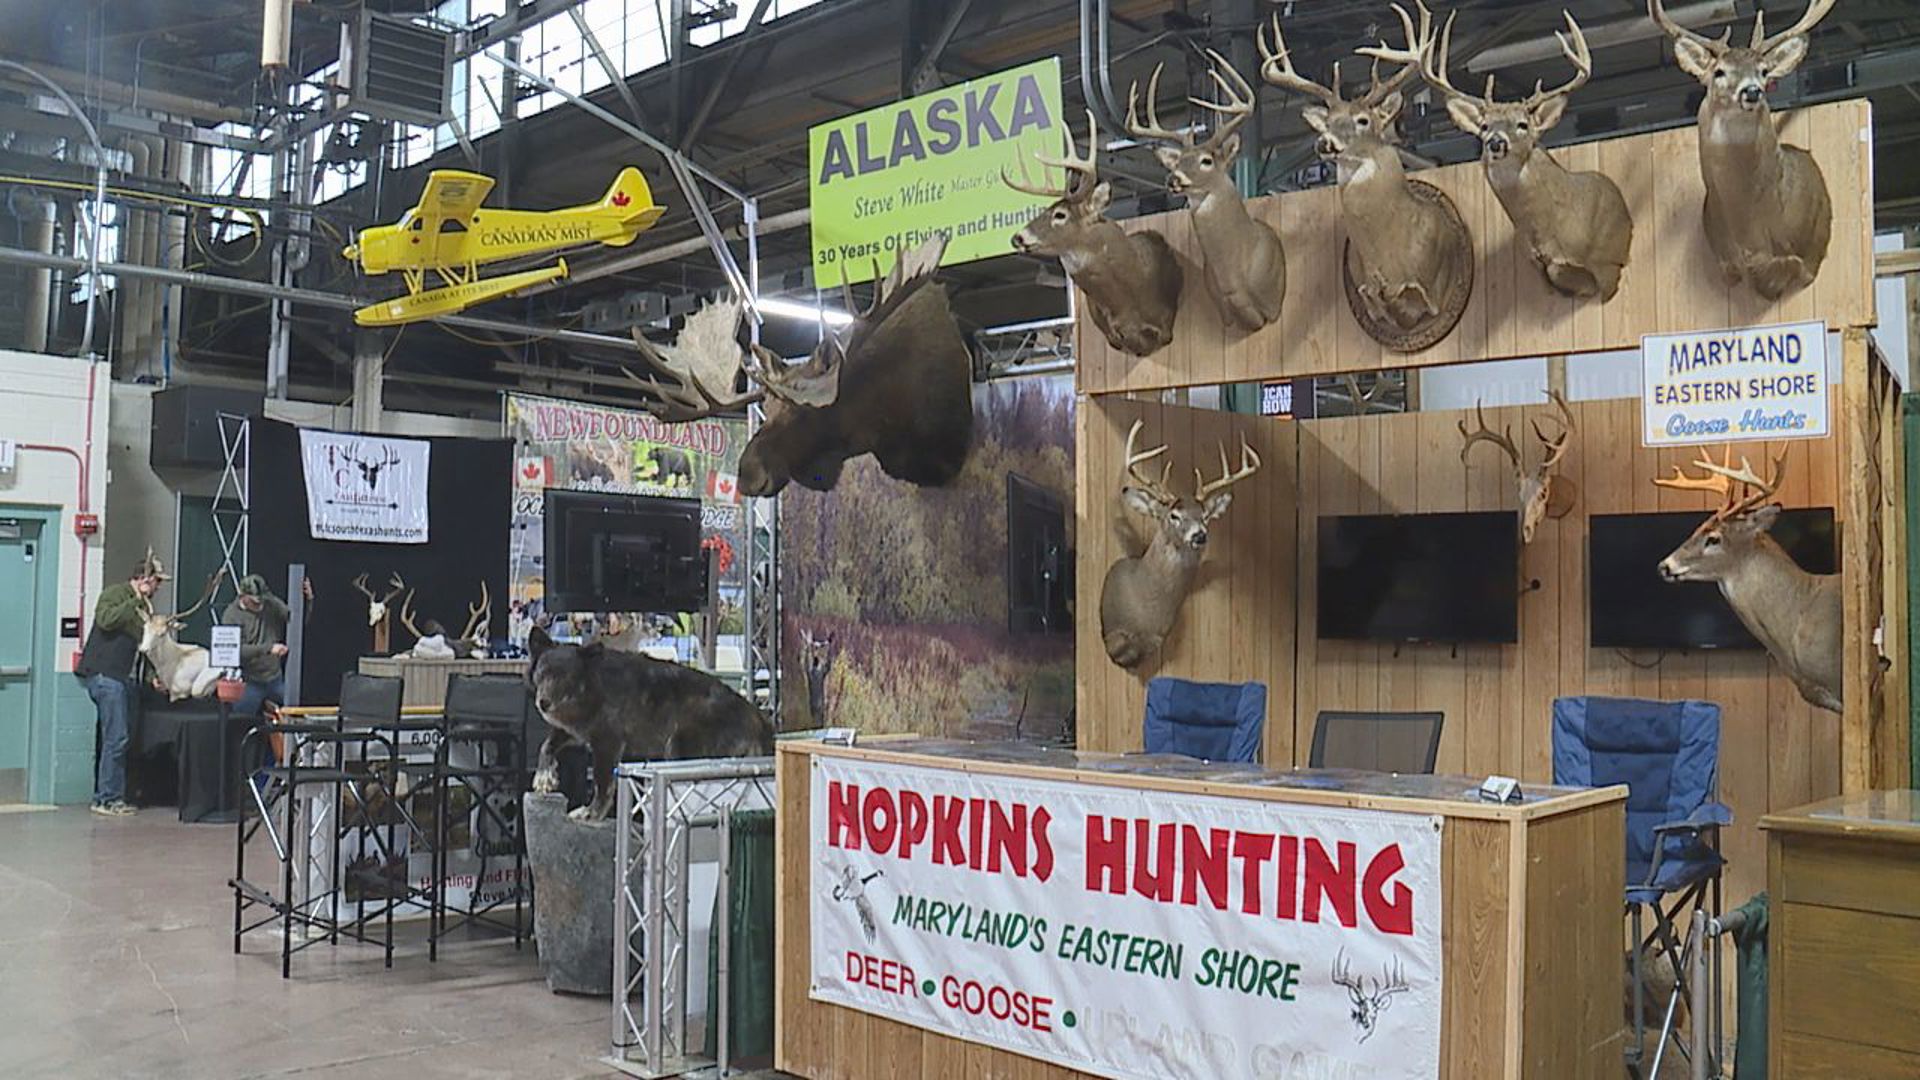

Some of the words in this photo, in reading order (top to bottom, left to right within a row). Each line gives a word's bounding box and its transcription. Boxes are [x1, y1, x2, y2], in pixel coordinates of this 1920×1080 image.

[819, 74, 1052, 185] ALASKA
[854, 196, 894, 219] Steve
[900, 178, 945, 208] White
[951, 175, 983, 192] Master
[481, 227, 557, 246] CANADIAN
[561, 226, 592, 241] MIST
[819, 248, 836, 265] 30
[839, 242, 880, 260] Years
[957, 214, 987, 236] and
[1669, 333, 1801, 376] MARYLAND
[1655, 380, 1741, 404] EASTERN
[1749, 374, 1816, 398] SHORE
[533, 405, 727, 457] NEWFOUNDLAND
[1666, 413, 1730, 436] Goose
[1738, 408, 1807, 432] Hunts
[828, 780, 1054, 884] HOPKINS
[1085, 814, 1414, 936] HUNTING
[891, 894, 1048, 953] MARYLAND'S
[1057, 923, 1184, 980] EASTERN
[1195, 947, 1301, 1001] SHORE
[846, 950, 919, 997] DEER
[942, 975, 1053, 1033] GOOSE
